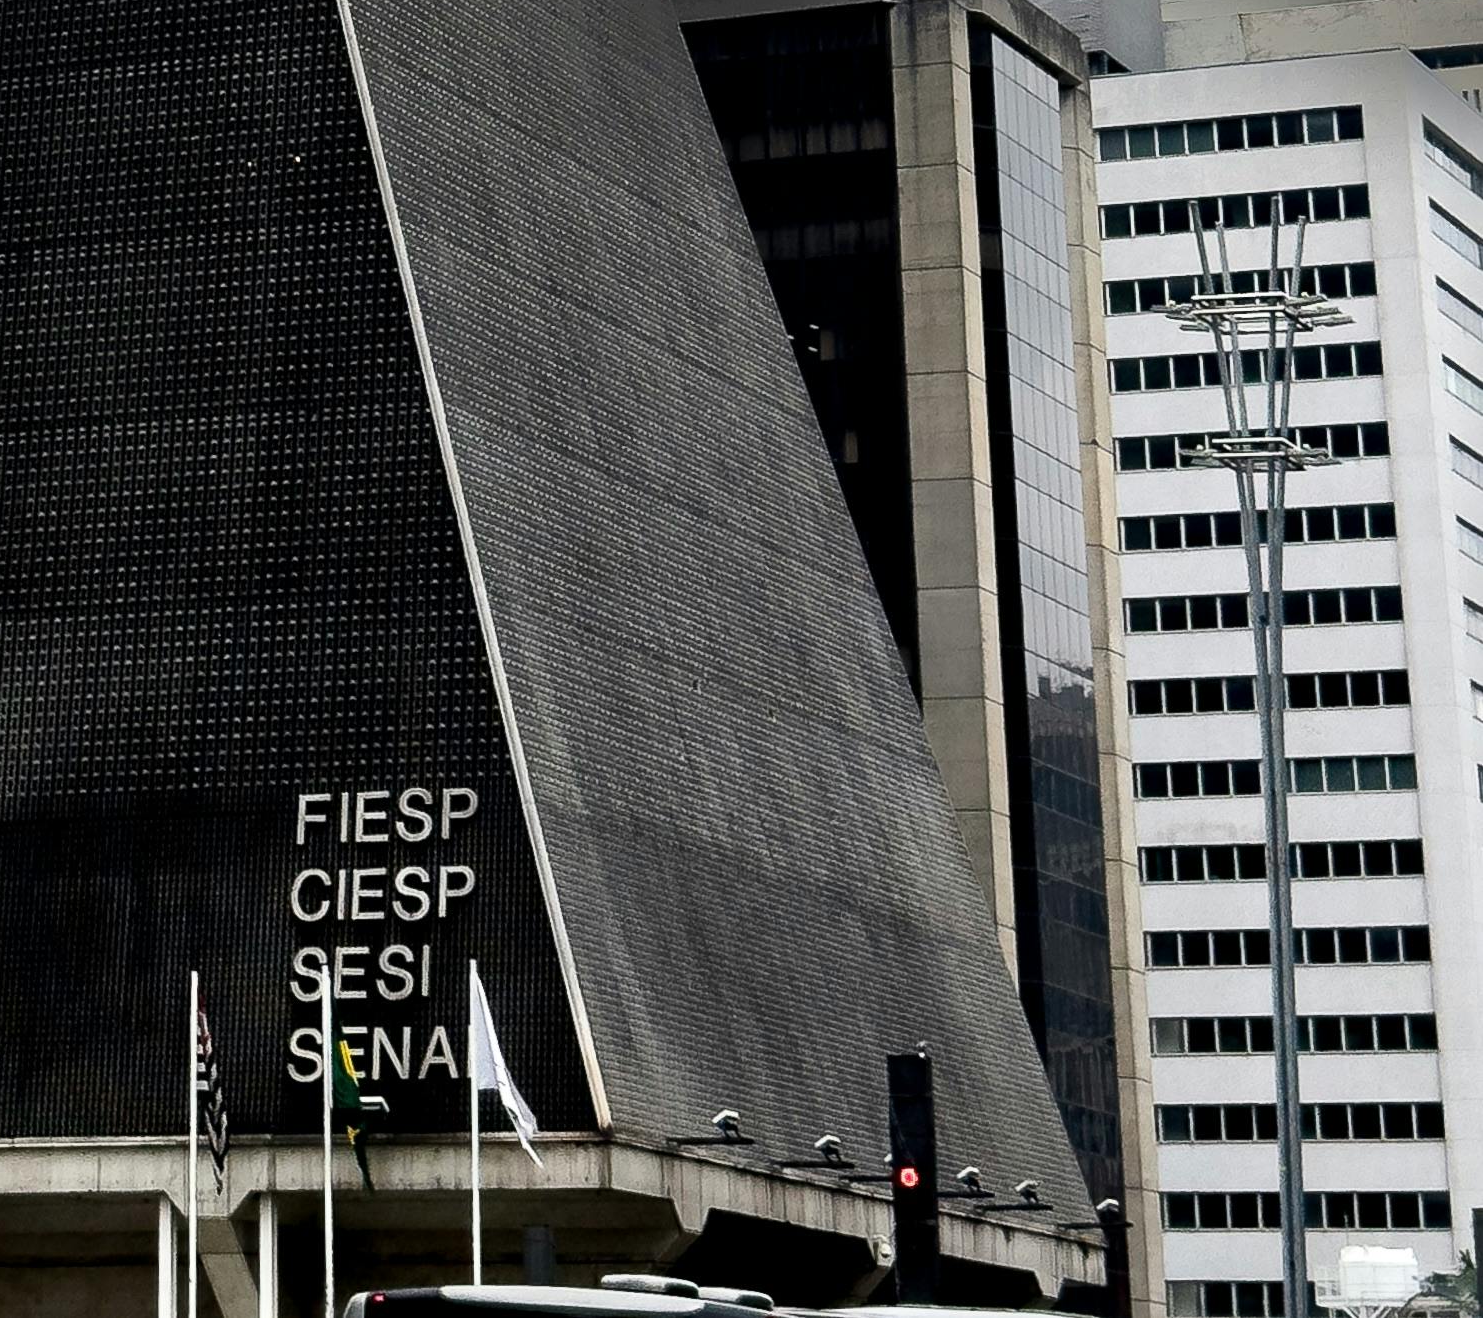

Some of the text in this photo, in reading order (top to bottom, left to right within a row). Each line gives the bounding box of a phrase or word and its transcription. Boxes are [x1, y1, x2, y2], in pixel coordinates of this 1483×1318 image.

[296, 787, 478, 845] FIESP
[290, 865, 476, 921] CIESP
[289, 944, 430, 1002] SESI
